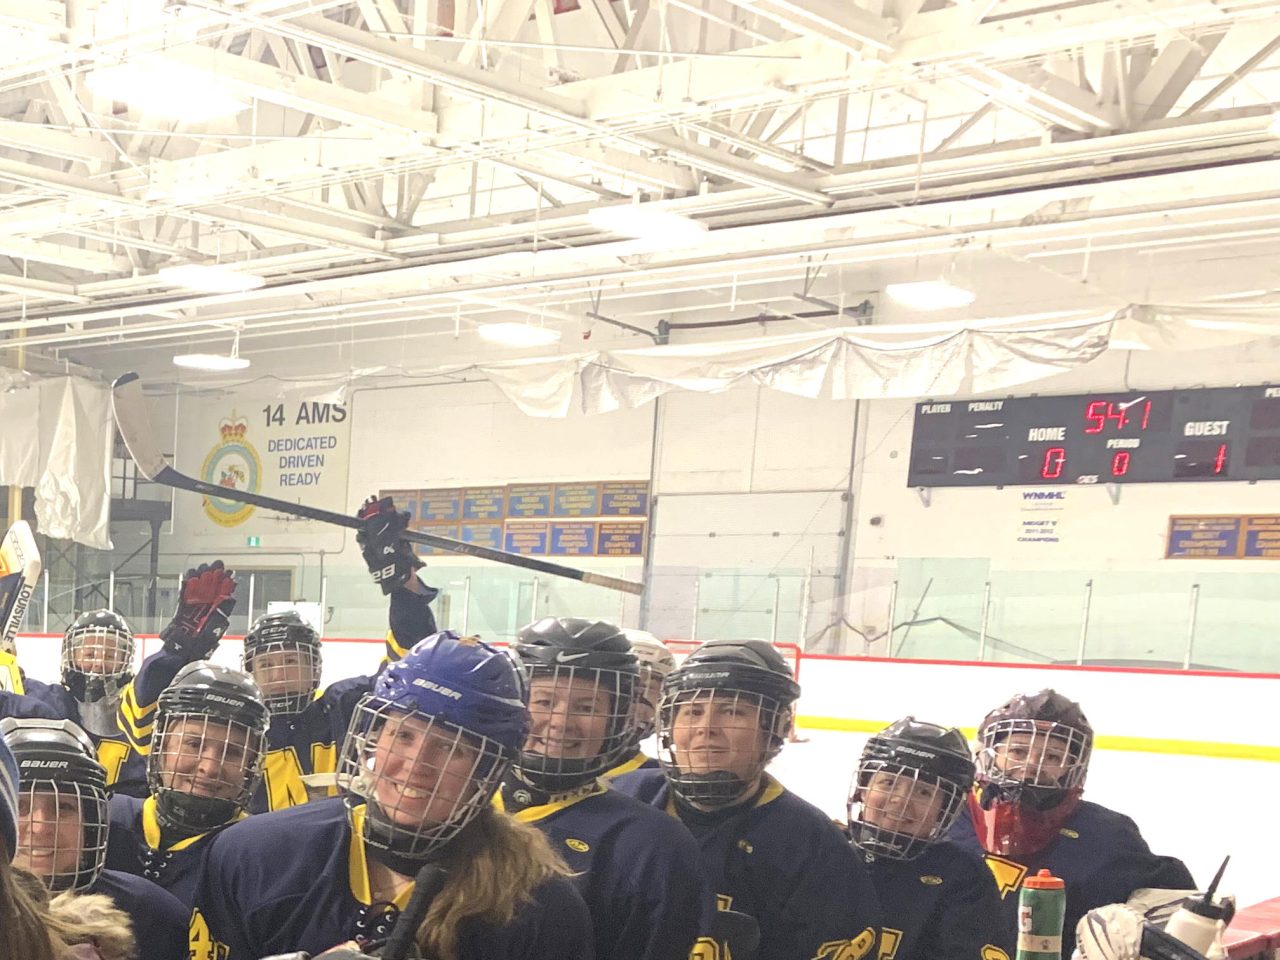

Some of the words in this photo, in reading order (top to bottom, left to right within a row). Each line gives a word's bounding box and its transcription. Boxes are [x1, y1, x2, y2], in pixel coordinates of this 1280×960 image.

[262, 403, 286, 427] 14
[295, 401, 348, 425] AMS
[921, 404, 952, 414] PLAYER
[968, 401, 1004, 412] PENALTY
[1028, 427, 1067, 441] HOME
[1184, 420, 1230, 436] GUEST
[267, 435, 338, 452] DEDICATED
[1106, 438, 1140, 449] PERIOD
[278, 454, 325, 469] DRIVEN
[1042, 447, 1066, 479] 0
[1111, 451, 1131, 476] 0
[279, 471, 322, 487] READY
[3, 583, 33, 644] LOUISVILLE
[412, 677, 463, 701] BAUER
[206, 693, 246, 708] BAUER
[20, 758, 69, 770] BAUER
